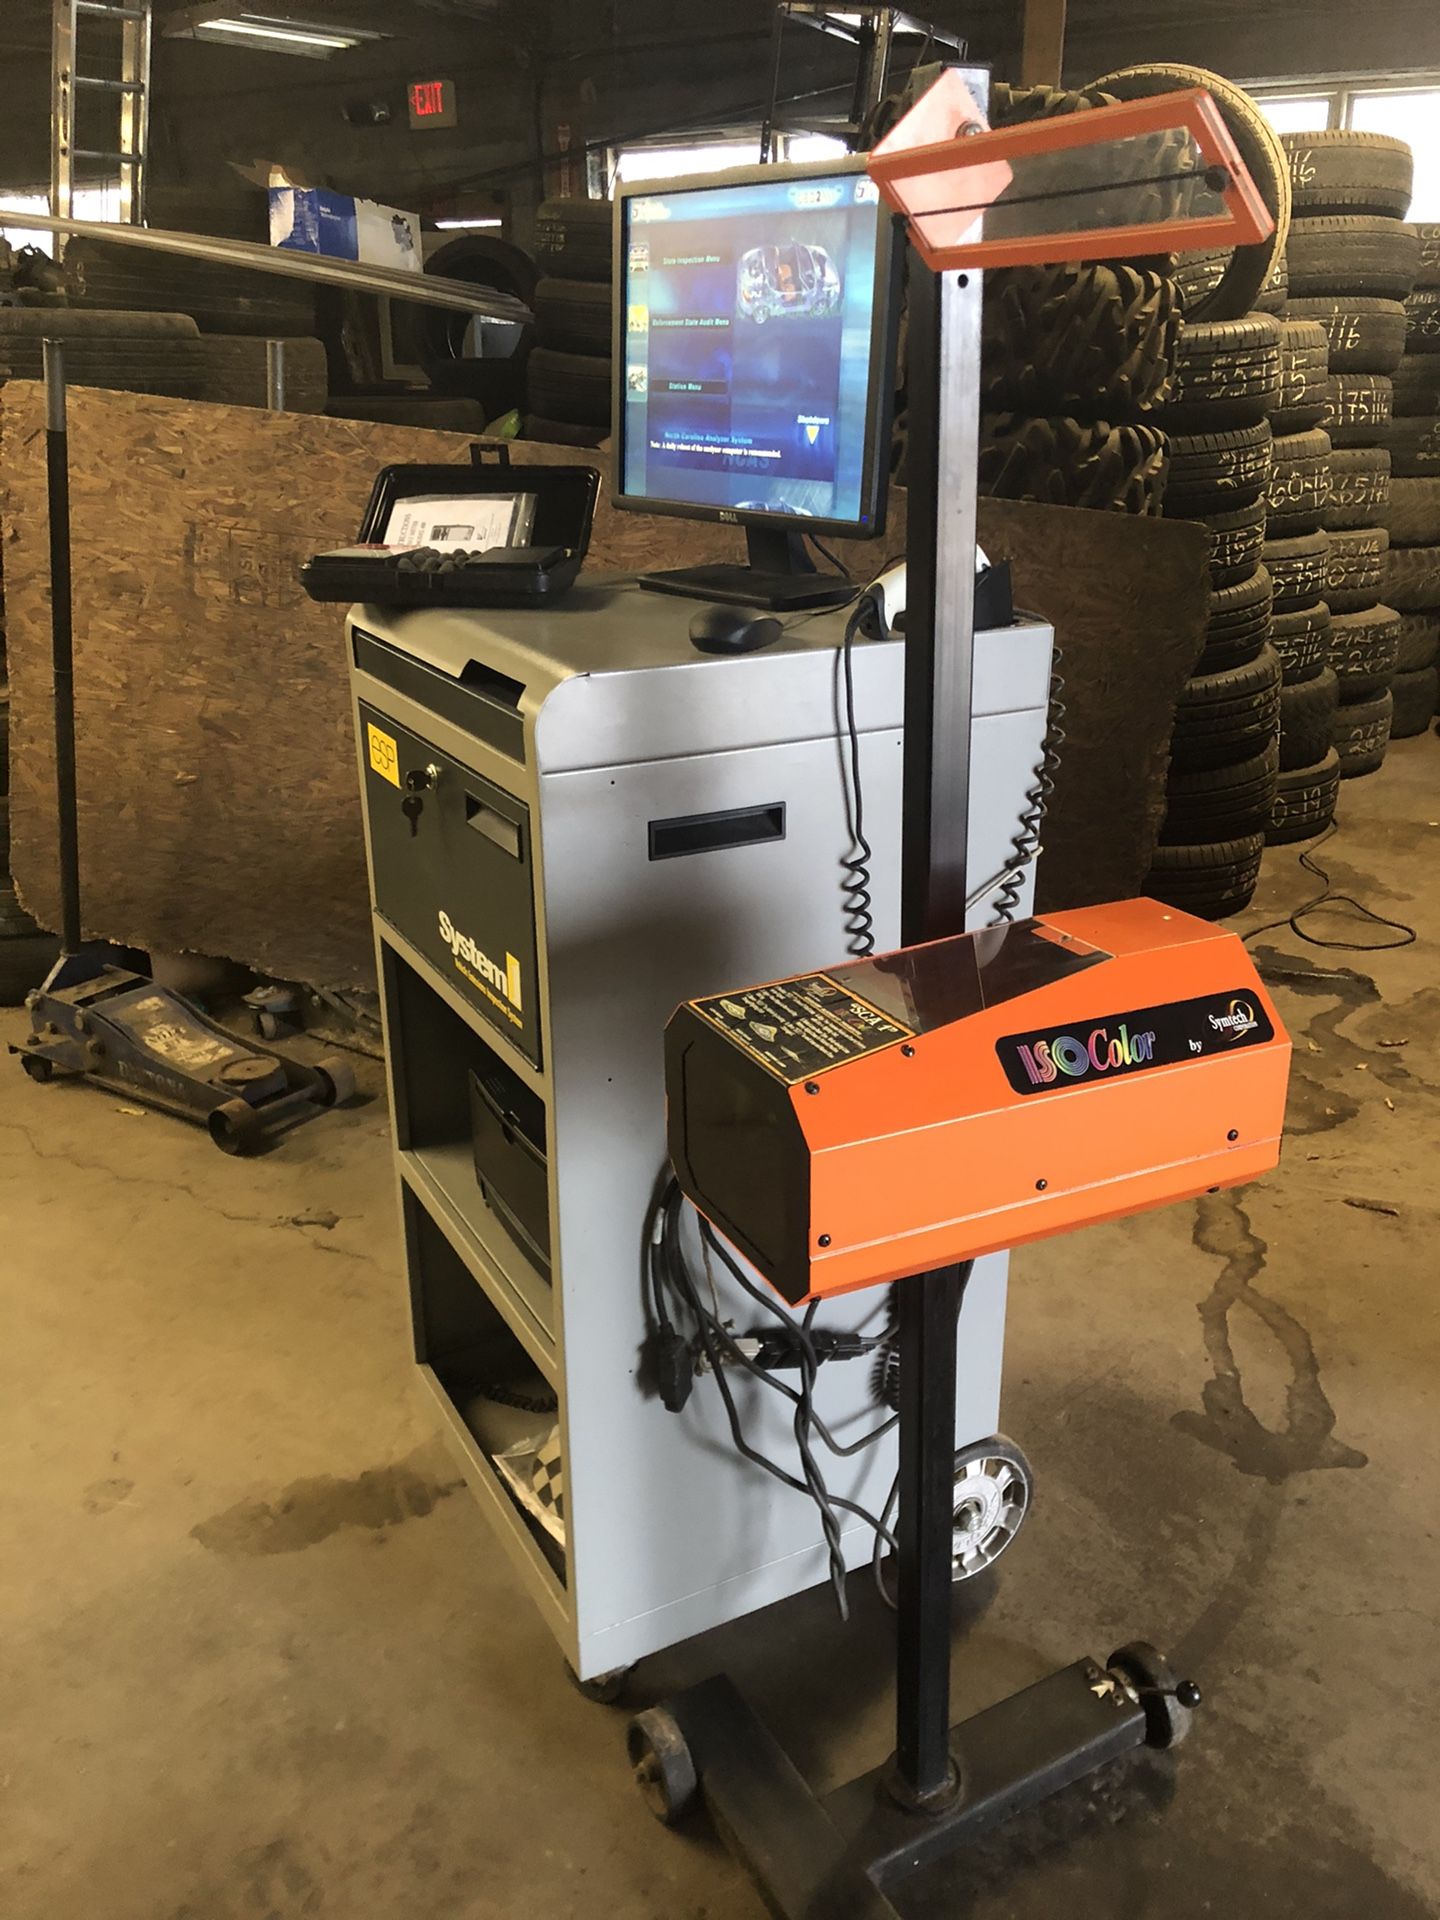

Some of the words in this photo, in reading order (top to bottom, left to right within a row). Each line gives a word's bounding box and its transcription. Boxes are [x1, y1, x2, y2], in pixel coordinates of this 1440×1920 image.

[414, 82, 442, 116] EXIT
[797, 414, 831, 426] Shutdown
[664, 431, 680, 440] North
[681, 432, 704, 441] Carolina
[719, 511, 738, 523] DELL
[1208, 1008, 1249, 1033] Symtech
[1188, 1039, 1203, 1053] by
